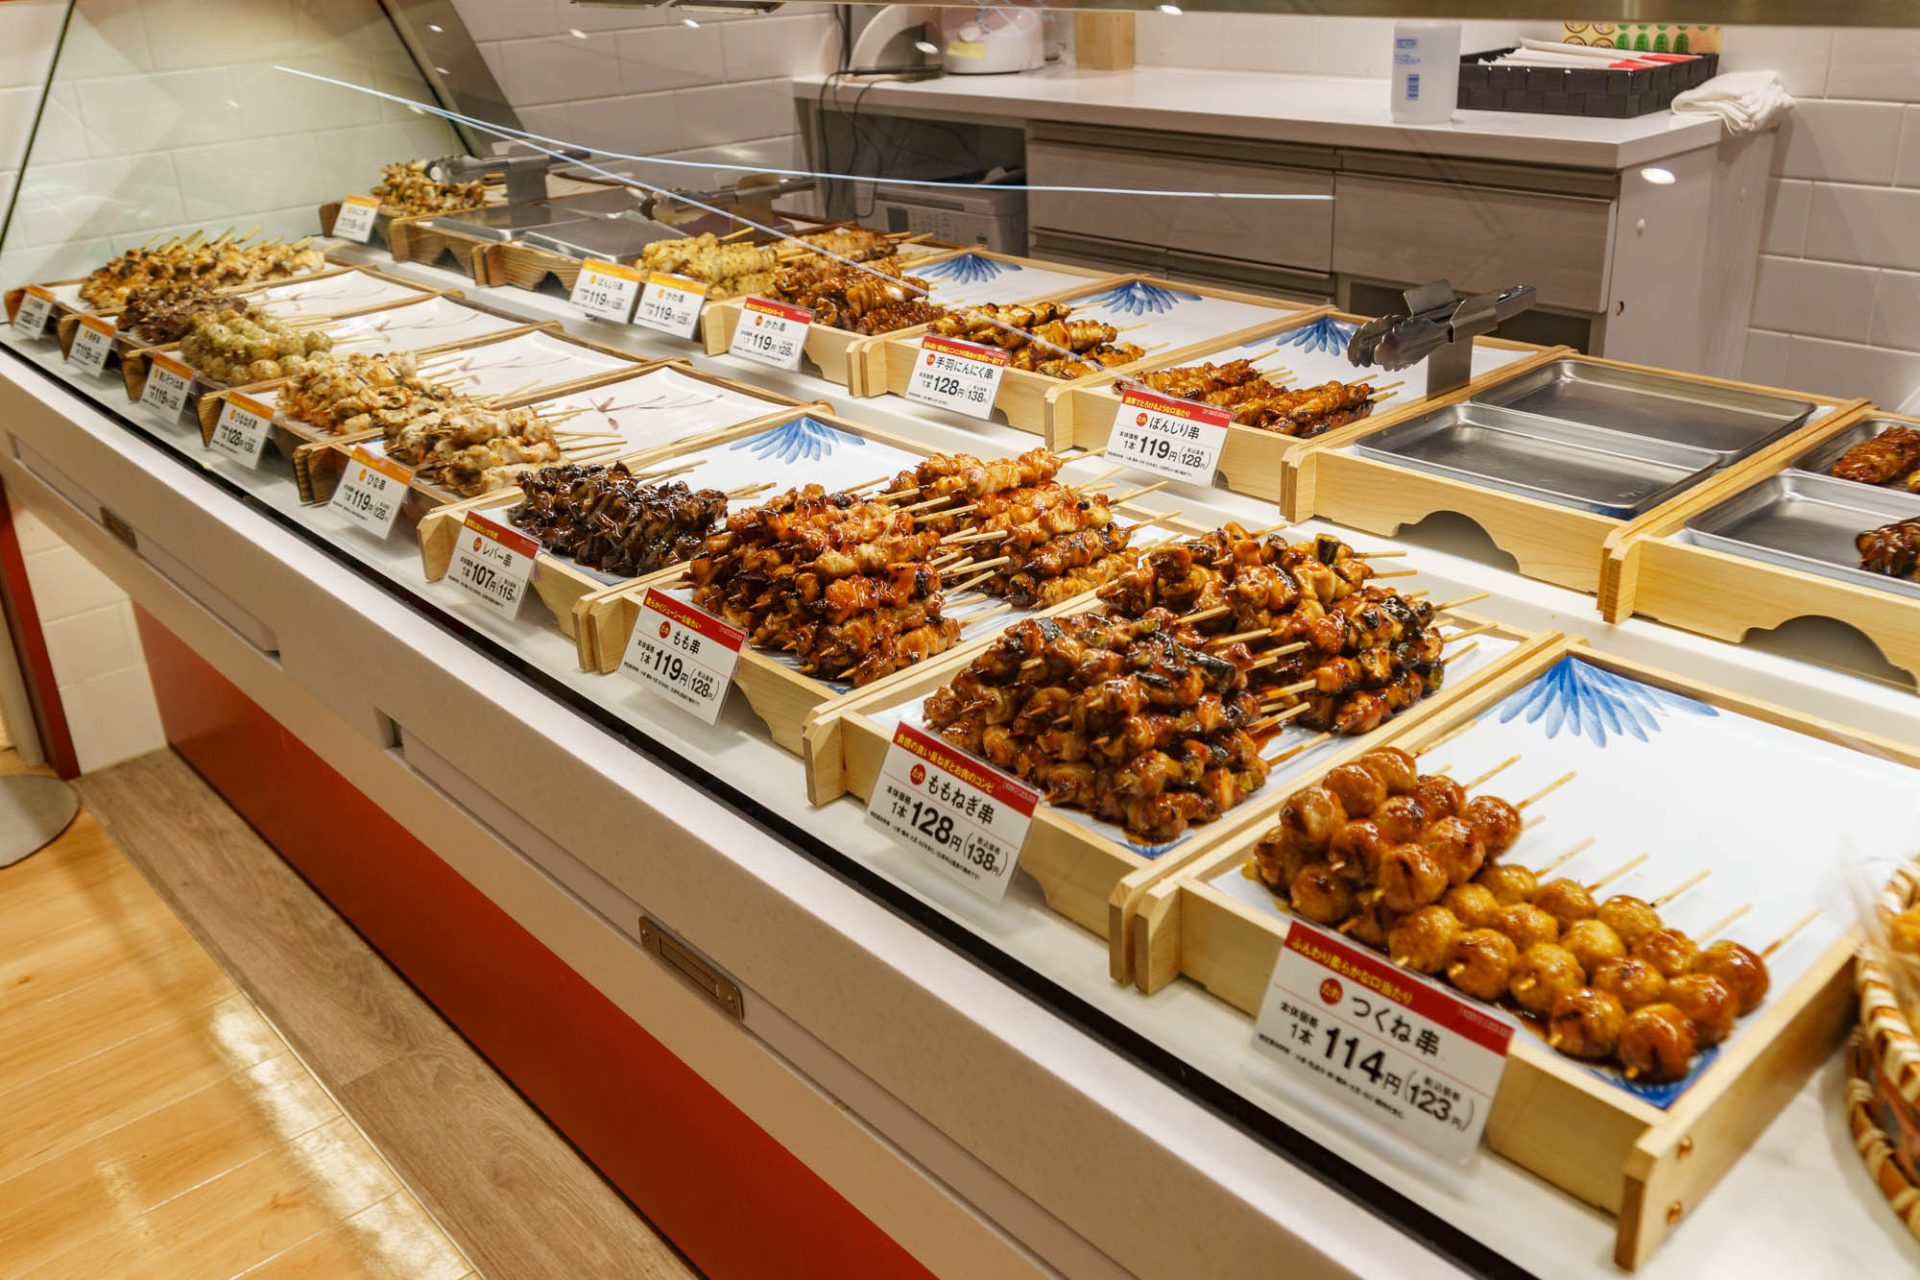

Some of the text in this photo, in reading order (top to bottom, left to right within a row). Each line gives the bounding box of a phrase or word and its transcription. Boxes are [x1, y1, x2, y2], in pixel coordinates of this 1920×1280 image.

[936, 356, 993, 379] 手羽にんにく串
[934, 376, 965, 398] 128円
[1149, 416, 1199, 439] ぼんじり串
[1124, 440, 1135, 449] 1本
[1139, 436, 1177, 461] 119円
[482, 543, 512, 567] レバー串
[673, 630, 700, 654] もも串
[640, 652, 651, 664] 1本
[654, 649, 688, 685] 119円
[897, 734, 994, 794] 食感の良い長ねぎとお肉のコンビ
[887, 786, 911, 804] 本体価格
[911, 768, 925, 782] たれ
[928, 775, 994, 824] ももねぎ串
[891, 801, 907, 817] 1本
[910, 801, 962, 851] 128円
[977, 836, 999, 854] 税込価格
[1292, 939, 1413, 1004] ふんわり柔らかな口当たり
[1281, 1002, 1317, 1027] 本体価格
[1322, 983, 1343, 1002] たれ
[1352, 997, 1439, 1055] つくね串
[1291, 1023, 1313, 1044] 1本
[1324, 1027, 1401, 1094] 114円
